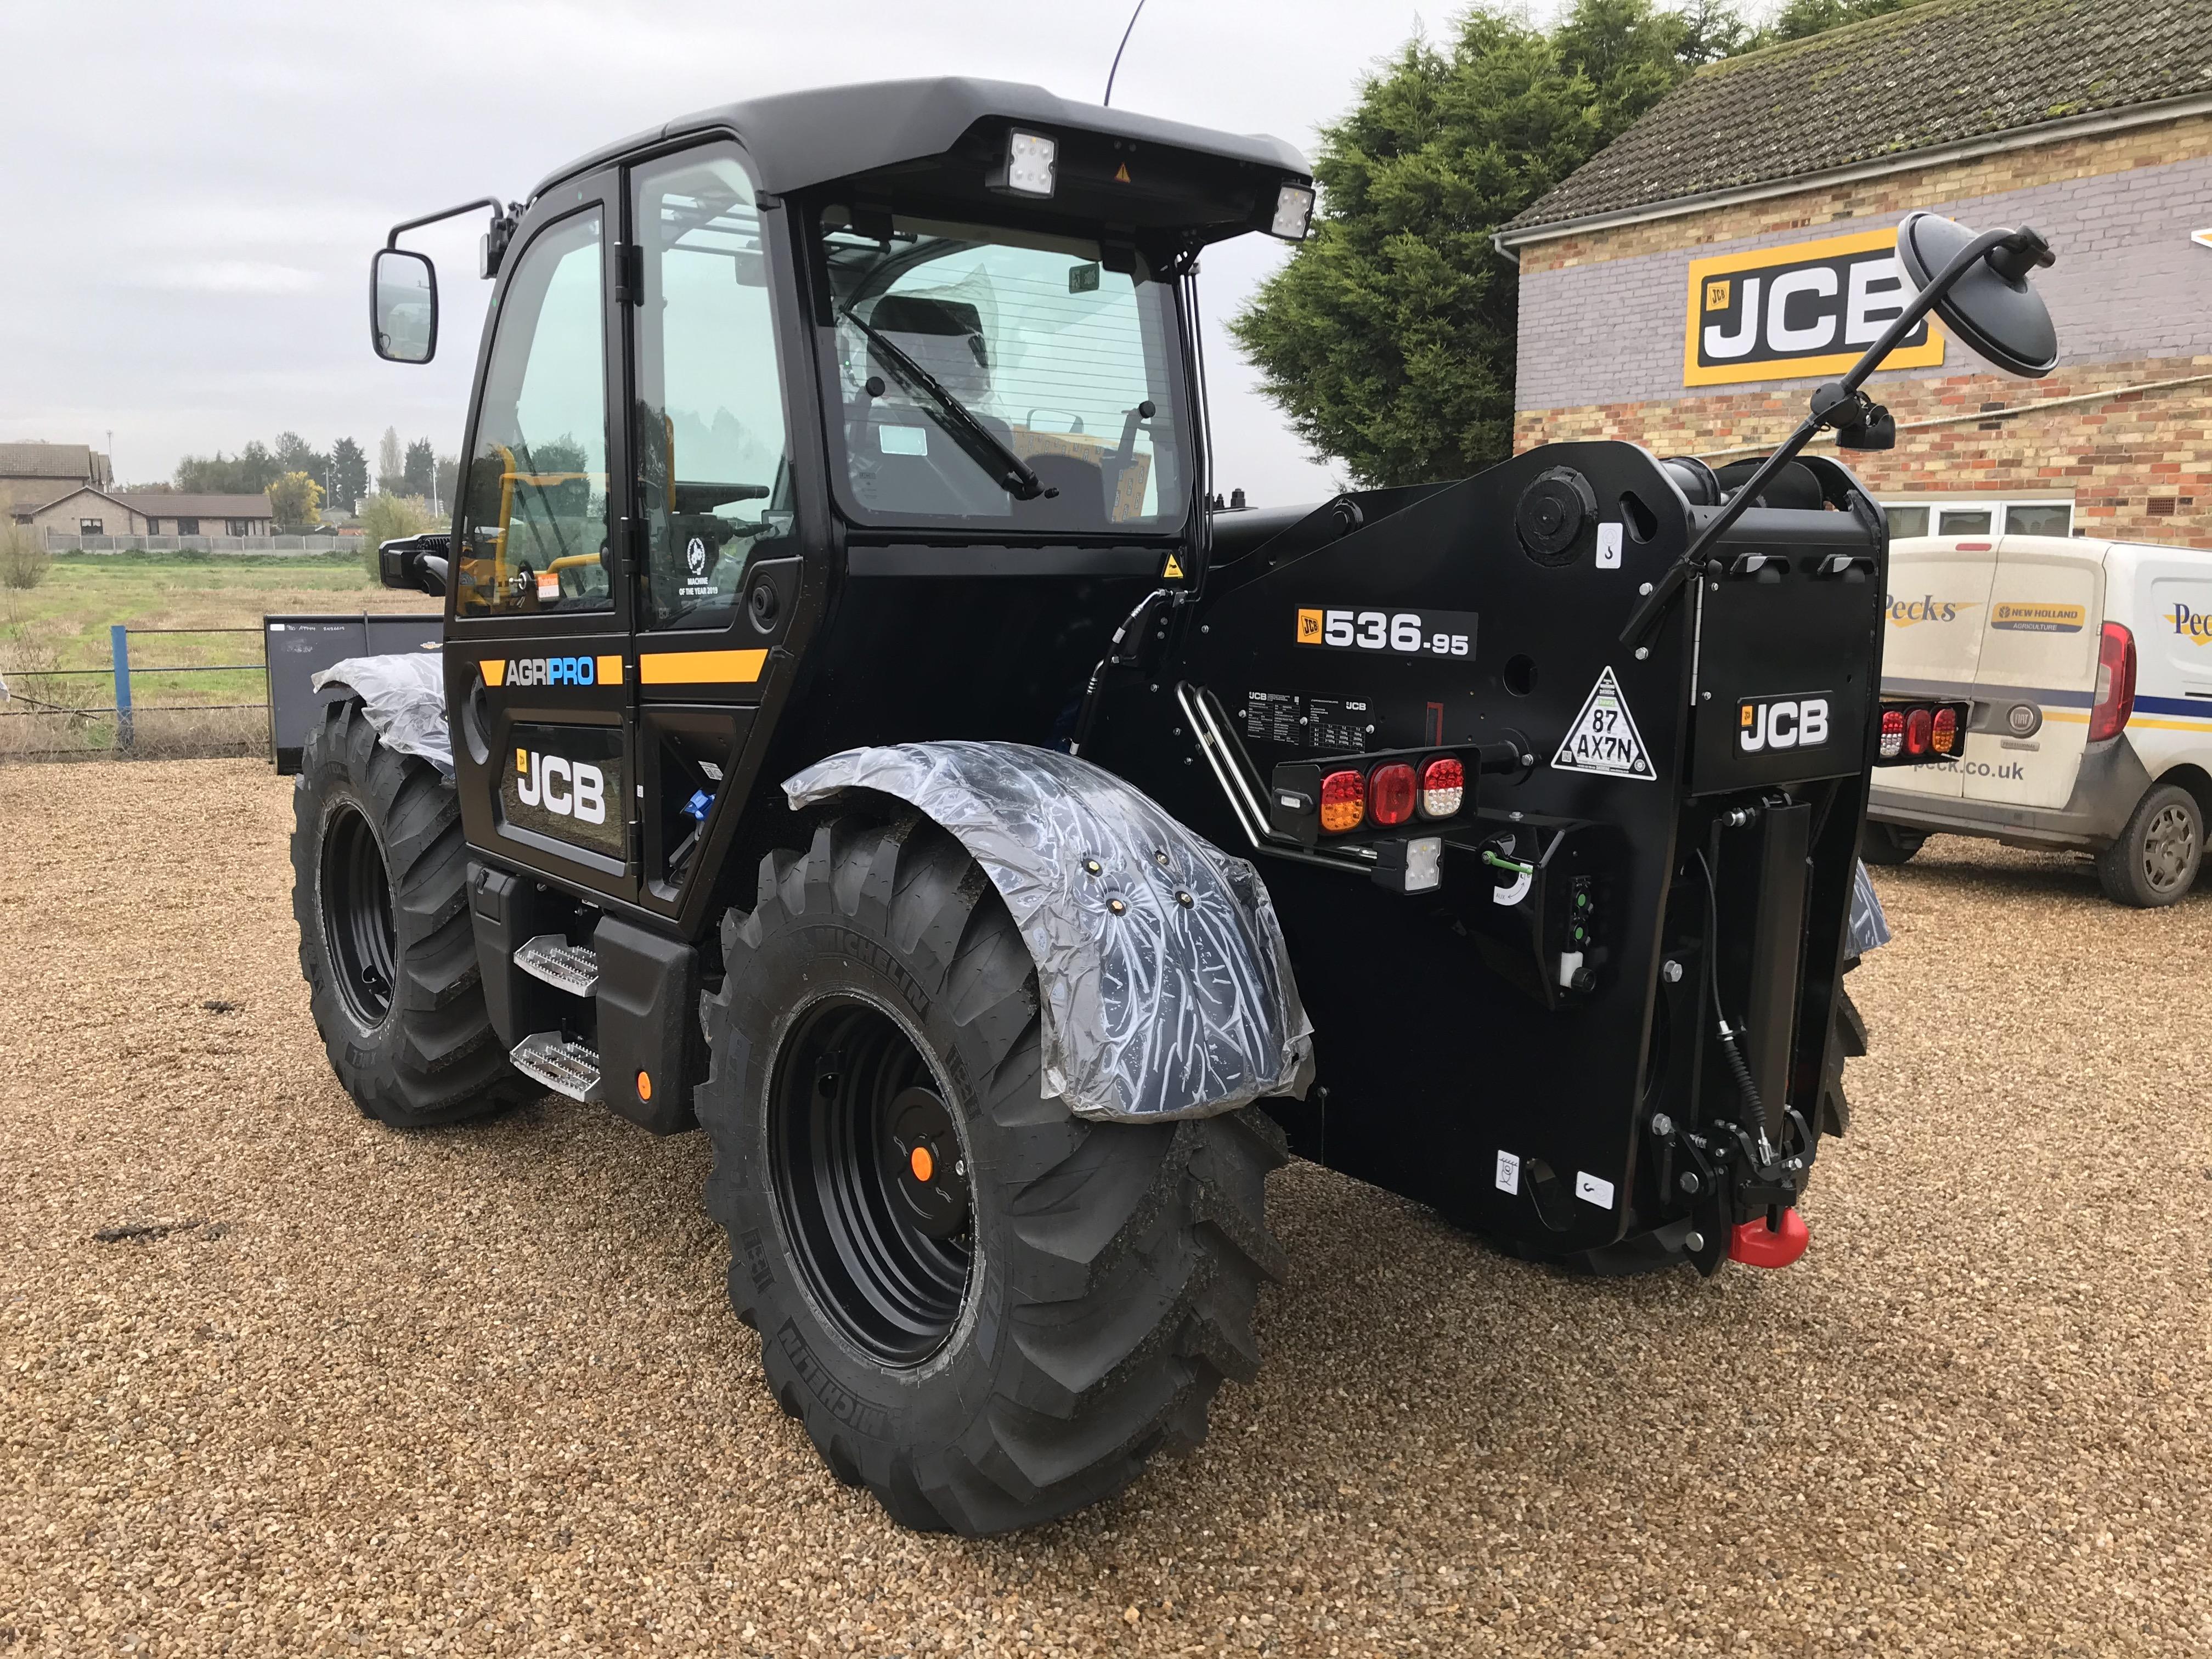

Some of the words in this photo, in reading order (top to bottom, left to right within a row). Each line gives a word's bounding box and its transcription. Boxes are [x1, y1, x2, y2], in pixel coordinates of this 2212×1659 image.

[1712, 289, 1725, 304] JCB
[1704, 257, 1921, 358] JCB
[687, 577, 708, 585] MACHINE
[695, 587, 707, 595] YEAR
[2012, 608, 2033, 617] NEW
[2034, 610, 2078, 619] HOLLAND
[1304, 618, 1318, 634] JCB
[2013, 623, 2058, 631] AGRICULTURE
[1249, 691, 1267, 701] JCB
[1346, 701, 1367, 711] JCB
[1593, 709, 1618, 734] 87
[1741, 699, 1829, 752] JCB
[2015, 714, 2029, 724] FIAT
[1577, 734, 1632, 763] AX7N
[517, 752, 605, 825] JCB
[815, 928, 929, 1013] MICHELIN
[777, 1327, 887, 1436] MICHELIN
